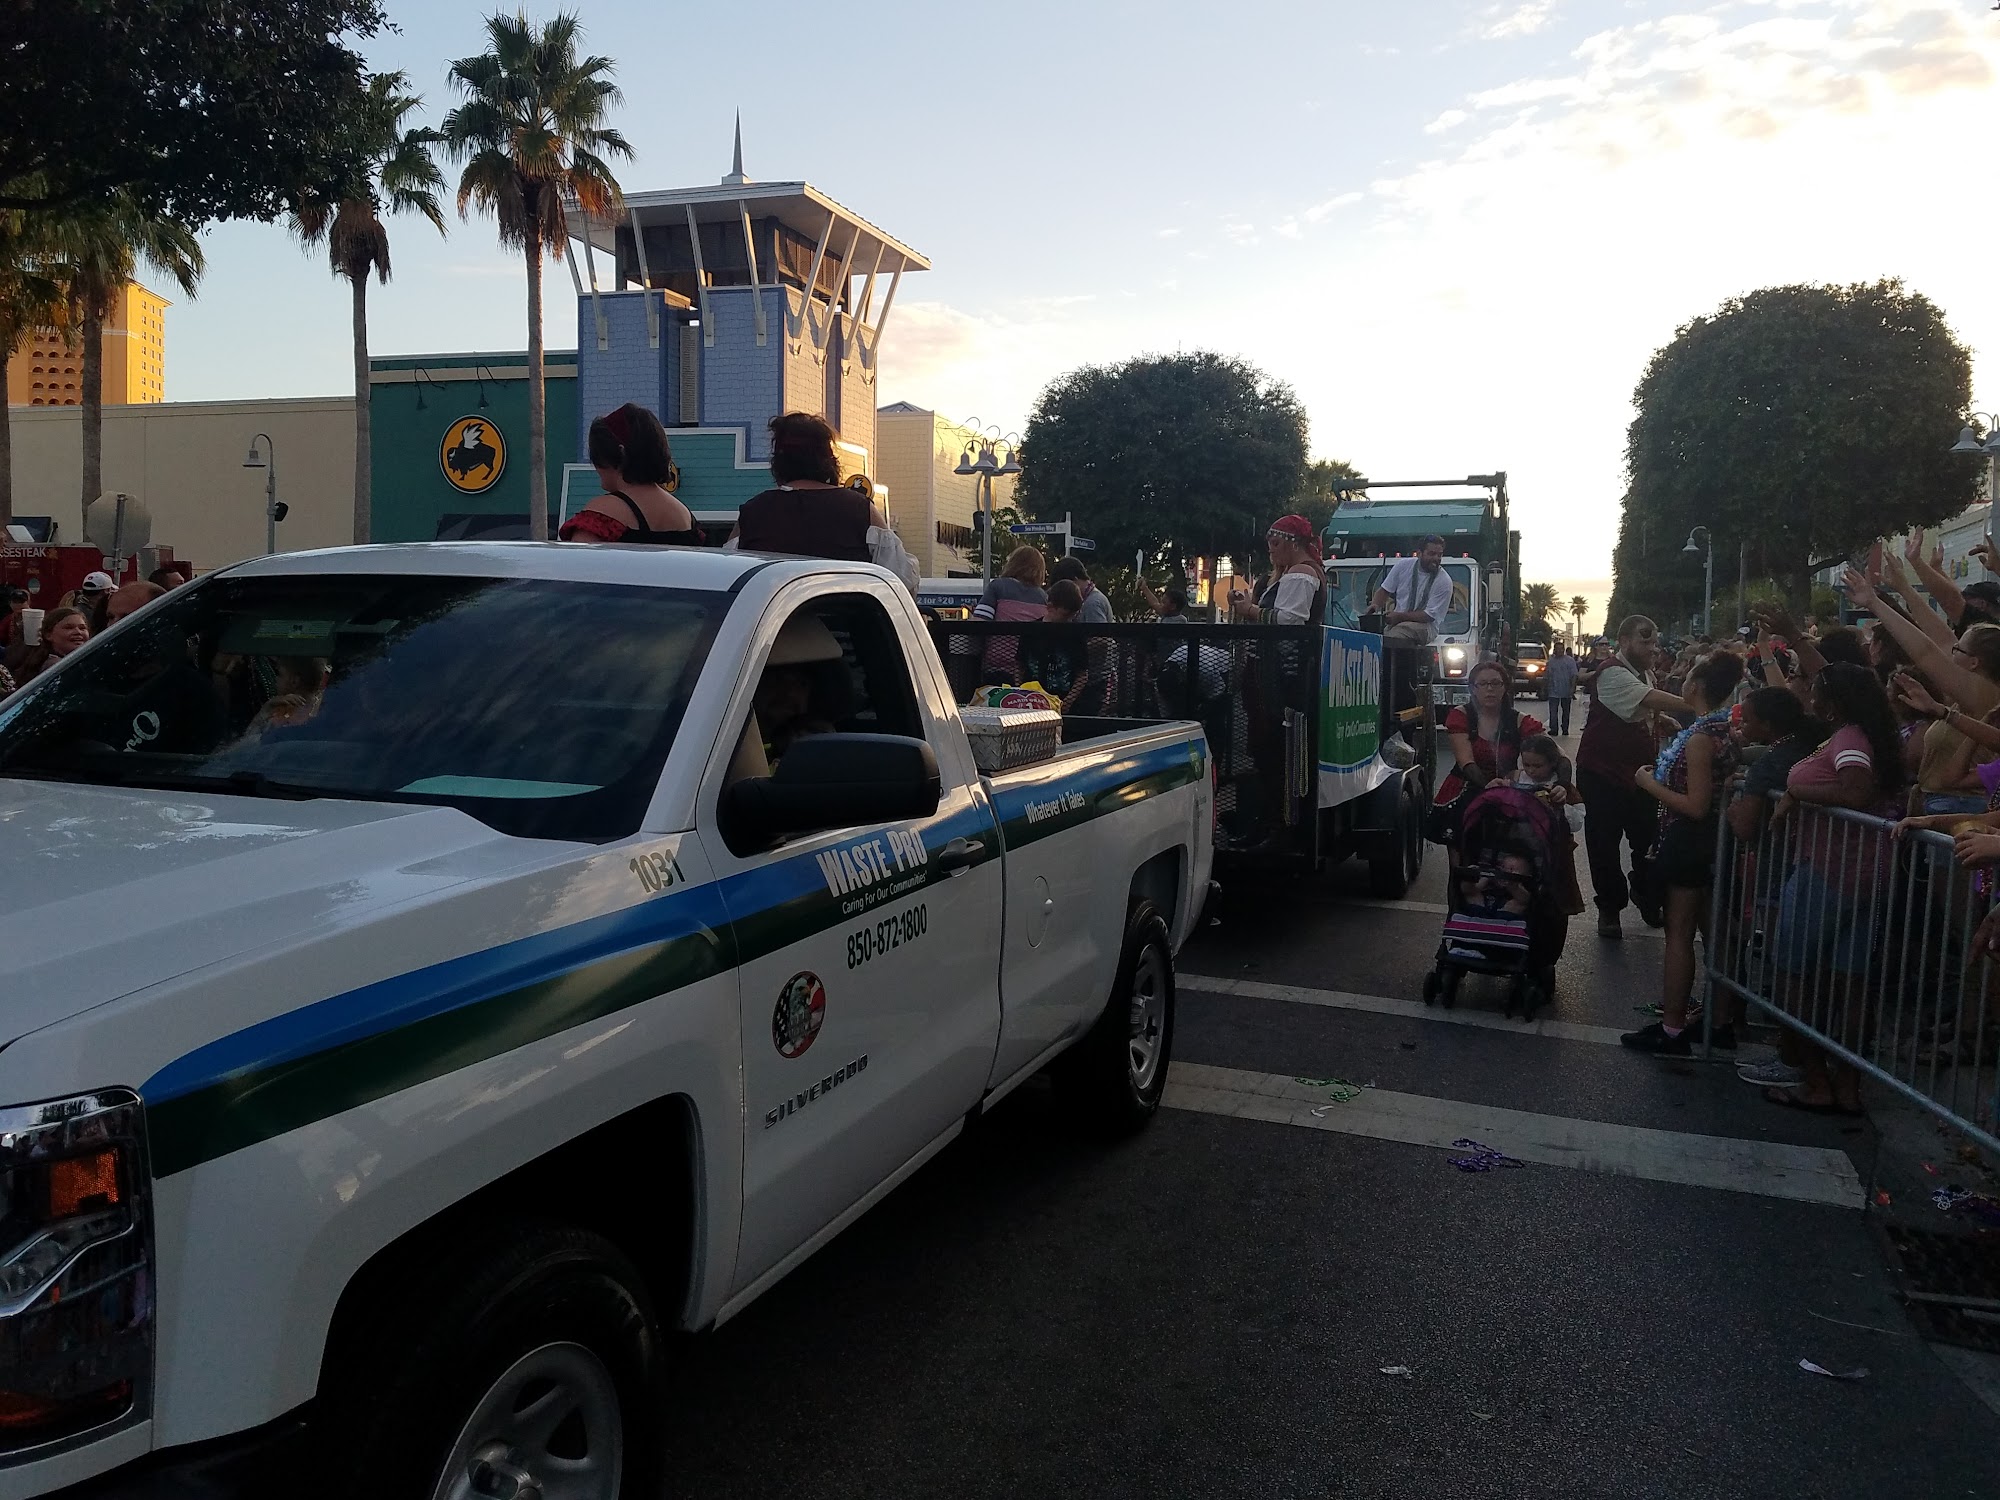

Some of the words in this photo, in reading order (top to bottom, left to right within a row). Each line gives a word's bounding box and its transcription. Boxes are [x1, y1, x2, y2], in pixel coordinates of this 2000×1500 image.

[1007, 698, 1029, 706] MARDI
[1024, 800, 1060, 824] Whatever
[1059, 793, 1068, 813] It
[1065, 788, 1086, 810] Takes
[629, 848, 686, 894] 1031
[815, 839, 892, 898] WASTE
[886, 827, 928, 873] PRO
[842, 897, 864, 914] Caring
[865, 892, 876, 904] For
[876, 887, 888, 900] Our
[847, 903, 927, 970] 850-872-1800
[765, 1053, 868, 1130] SILVERADO
